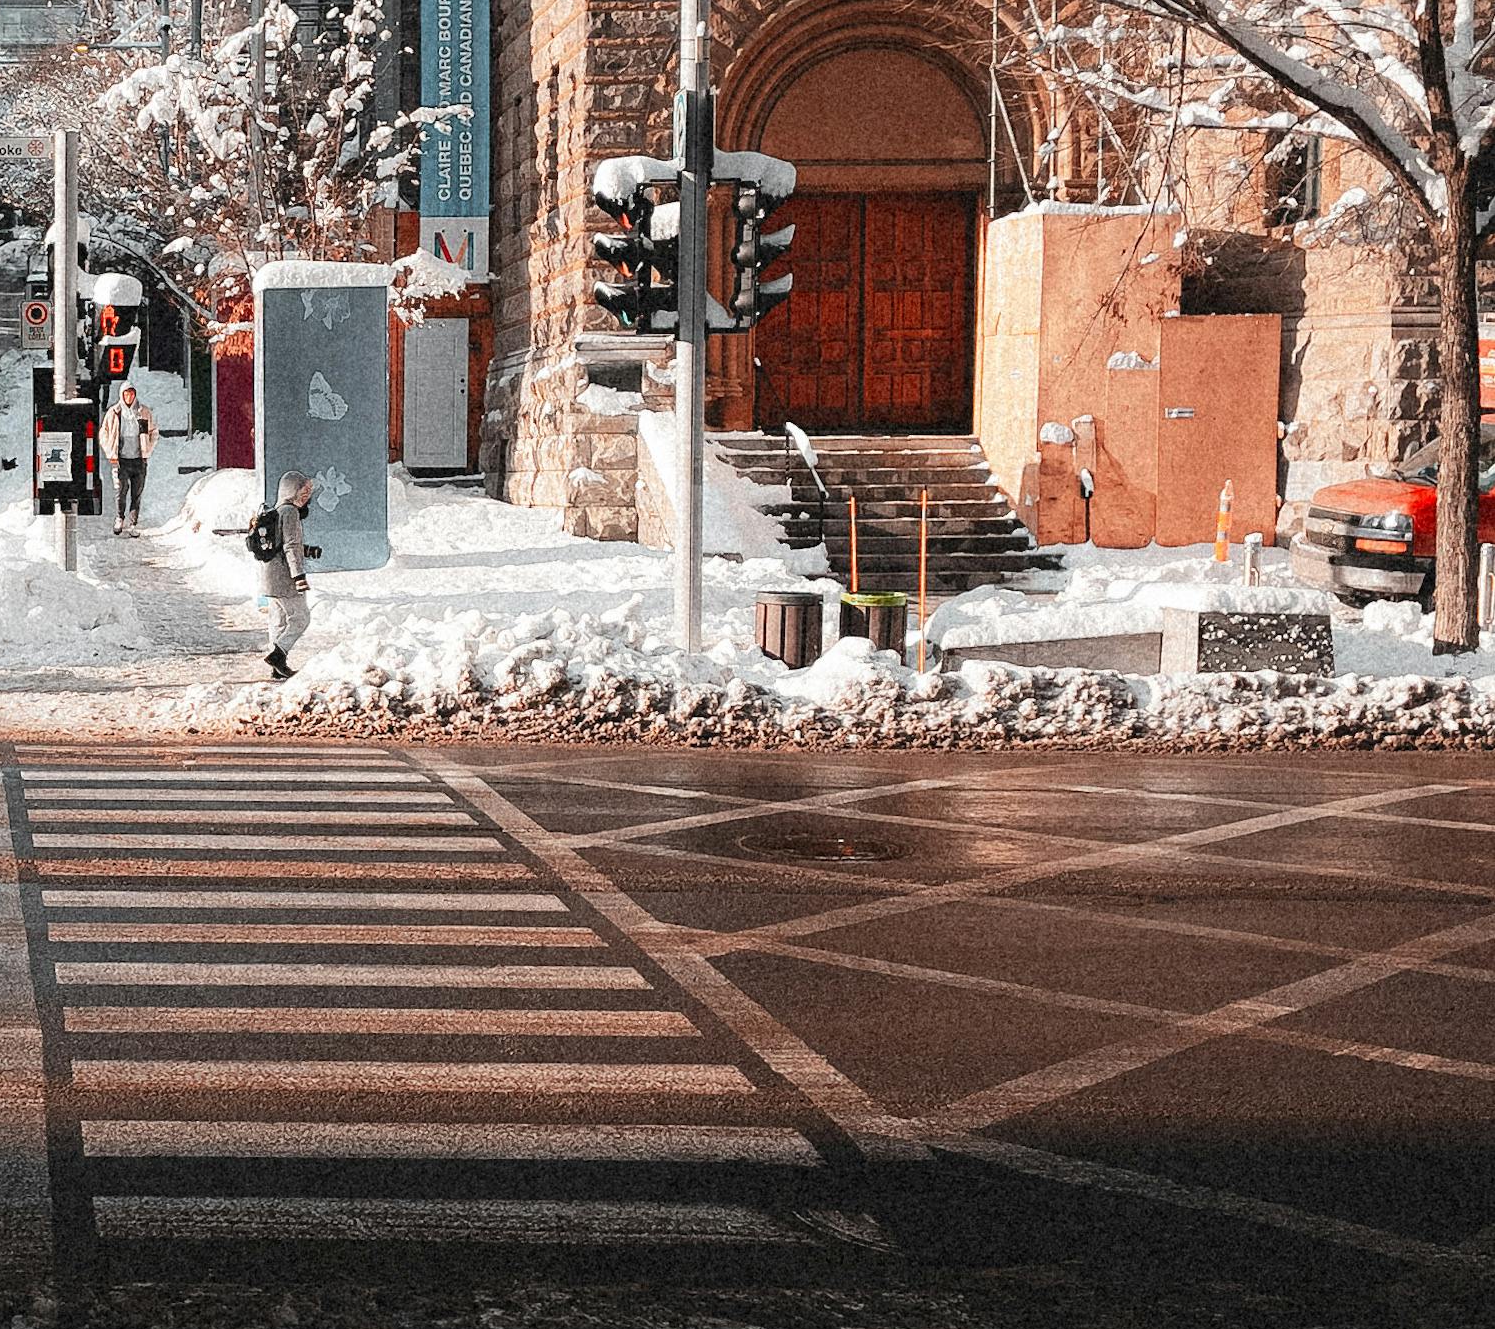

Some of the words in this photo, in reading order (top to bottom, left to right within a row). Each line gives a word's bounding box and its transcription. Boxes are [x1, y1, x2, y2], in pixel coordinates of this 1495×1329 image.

[437, 46, 451, 96] MARC
[459, 0, 473, 87] CANADIAN
[438, 141, 452, 201] CLAIRE
[459, 131, 473, 201] QUEBEC
